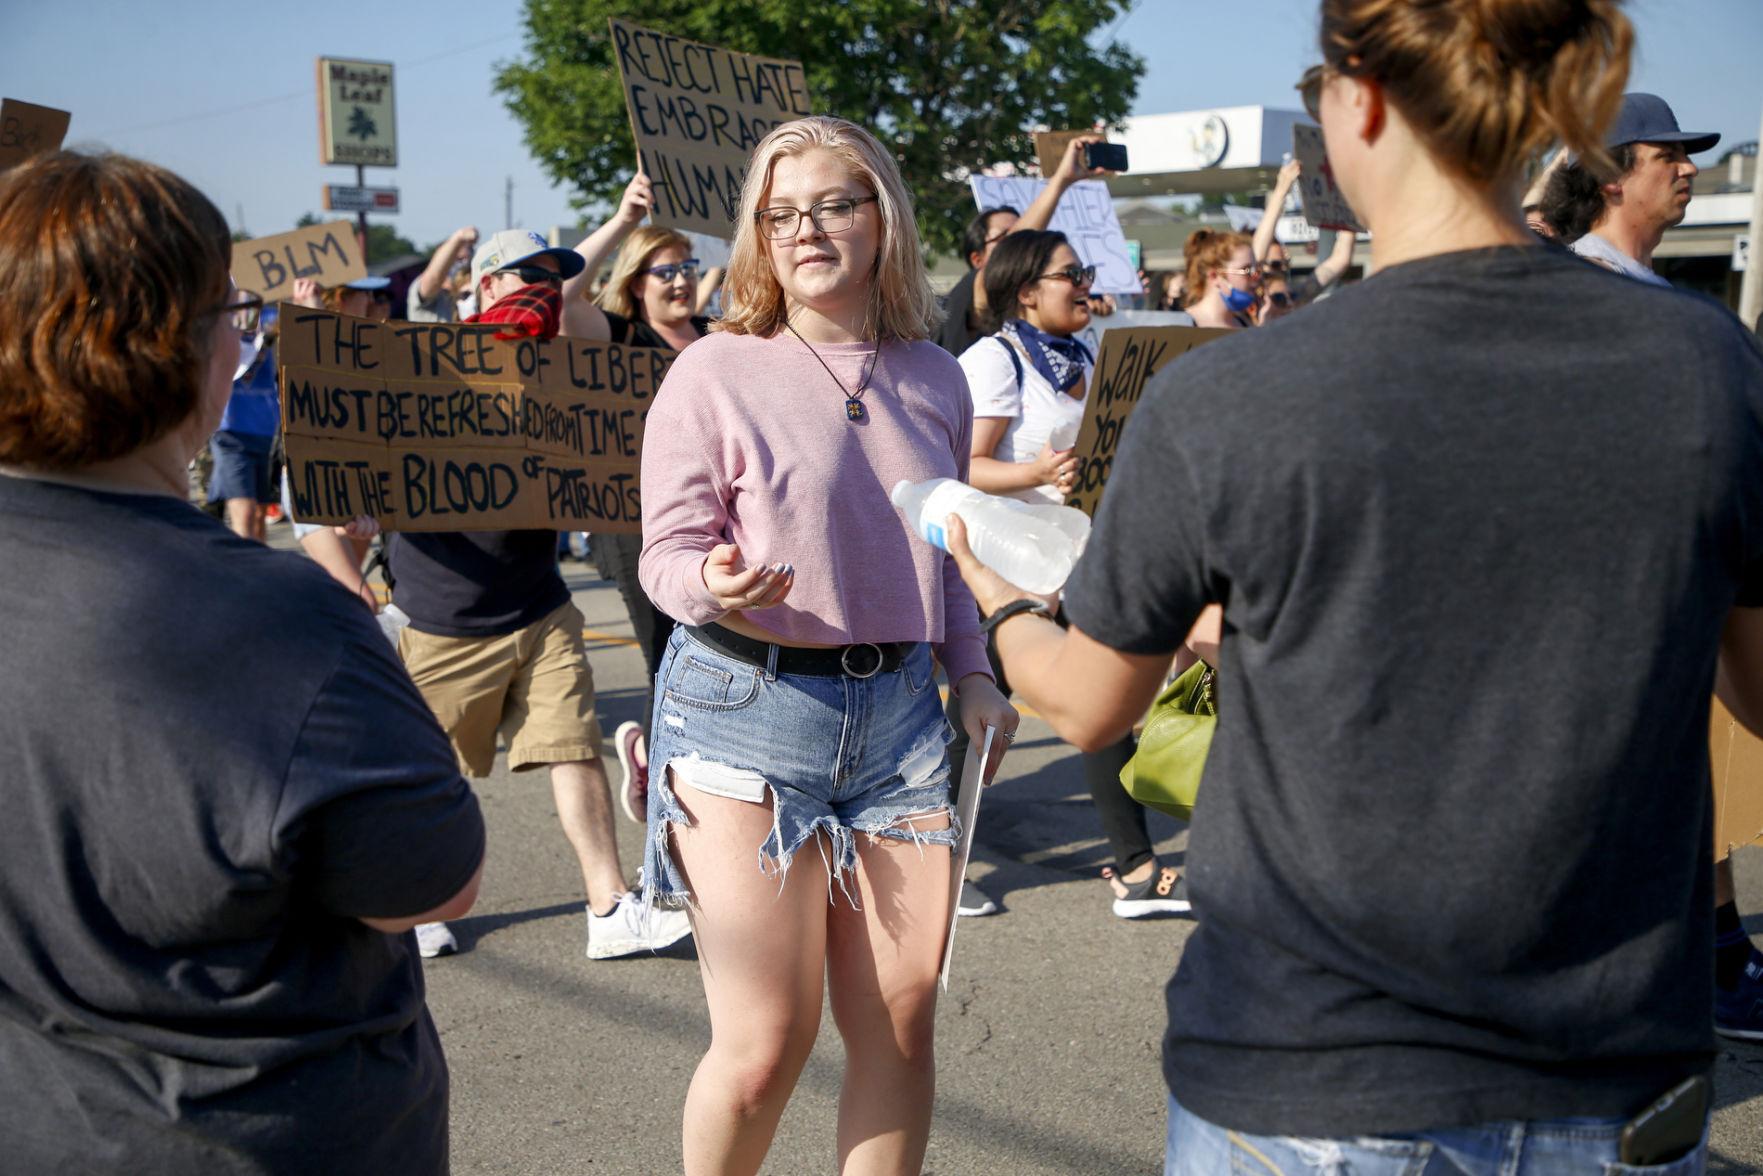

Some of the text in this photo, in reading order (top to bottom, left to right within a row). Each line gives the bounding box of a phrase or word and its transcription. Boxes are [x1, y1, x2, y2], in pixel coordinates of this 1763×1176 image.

[330, 64, 389, 86] Maple
[340, 82, 383, 105] Leaf
[613, 24, 810, 116] REJECT HATE
[631, 84, 784, 151] EMBRAC
[334, 145, 391, 160] SHOPS
[641, 149, 744, 221] HUMA
[252, 231, 350, 291] BLM
[295, 314, 676, 398] THE TREE OF LIBER
[289, 379, 636, 456] MUST BE REFRESHED FROM TIME
[286, 453, 641, 522] WITH THE BLOOD OF PATRIOTS
